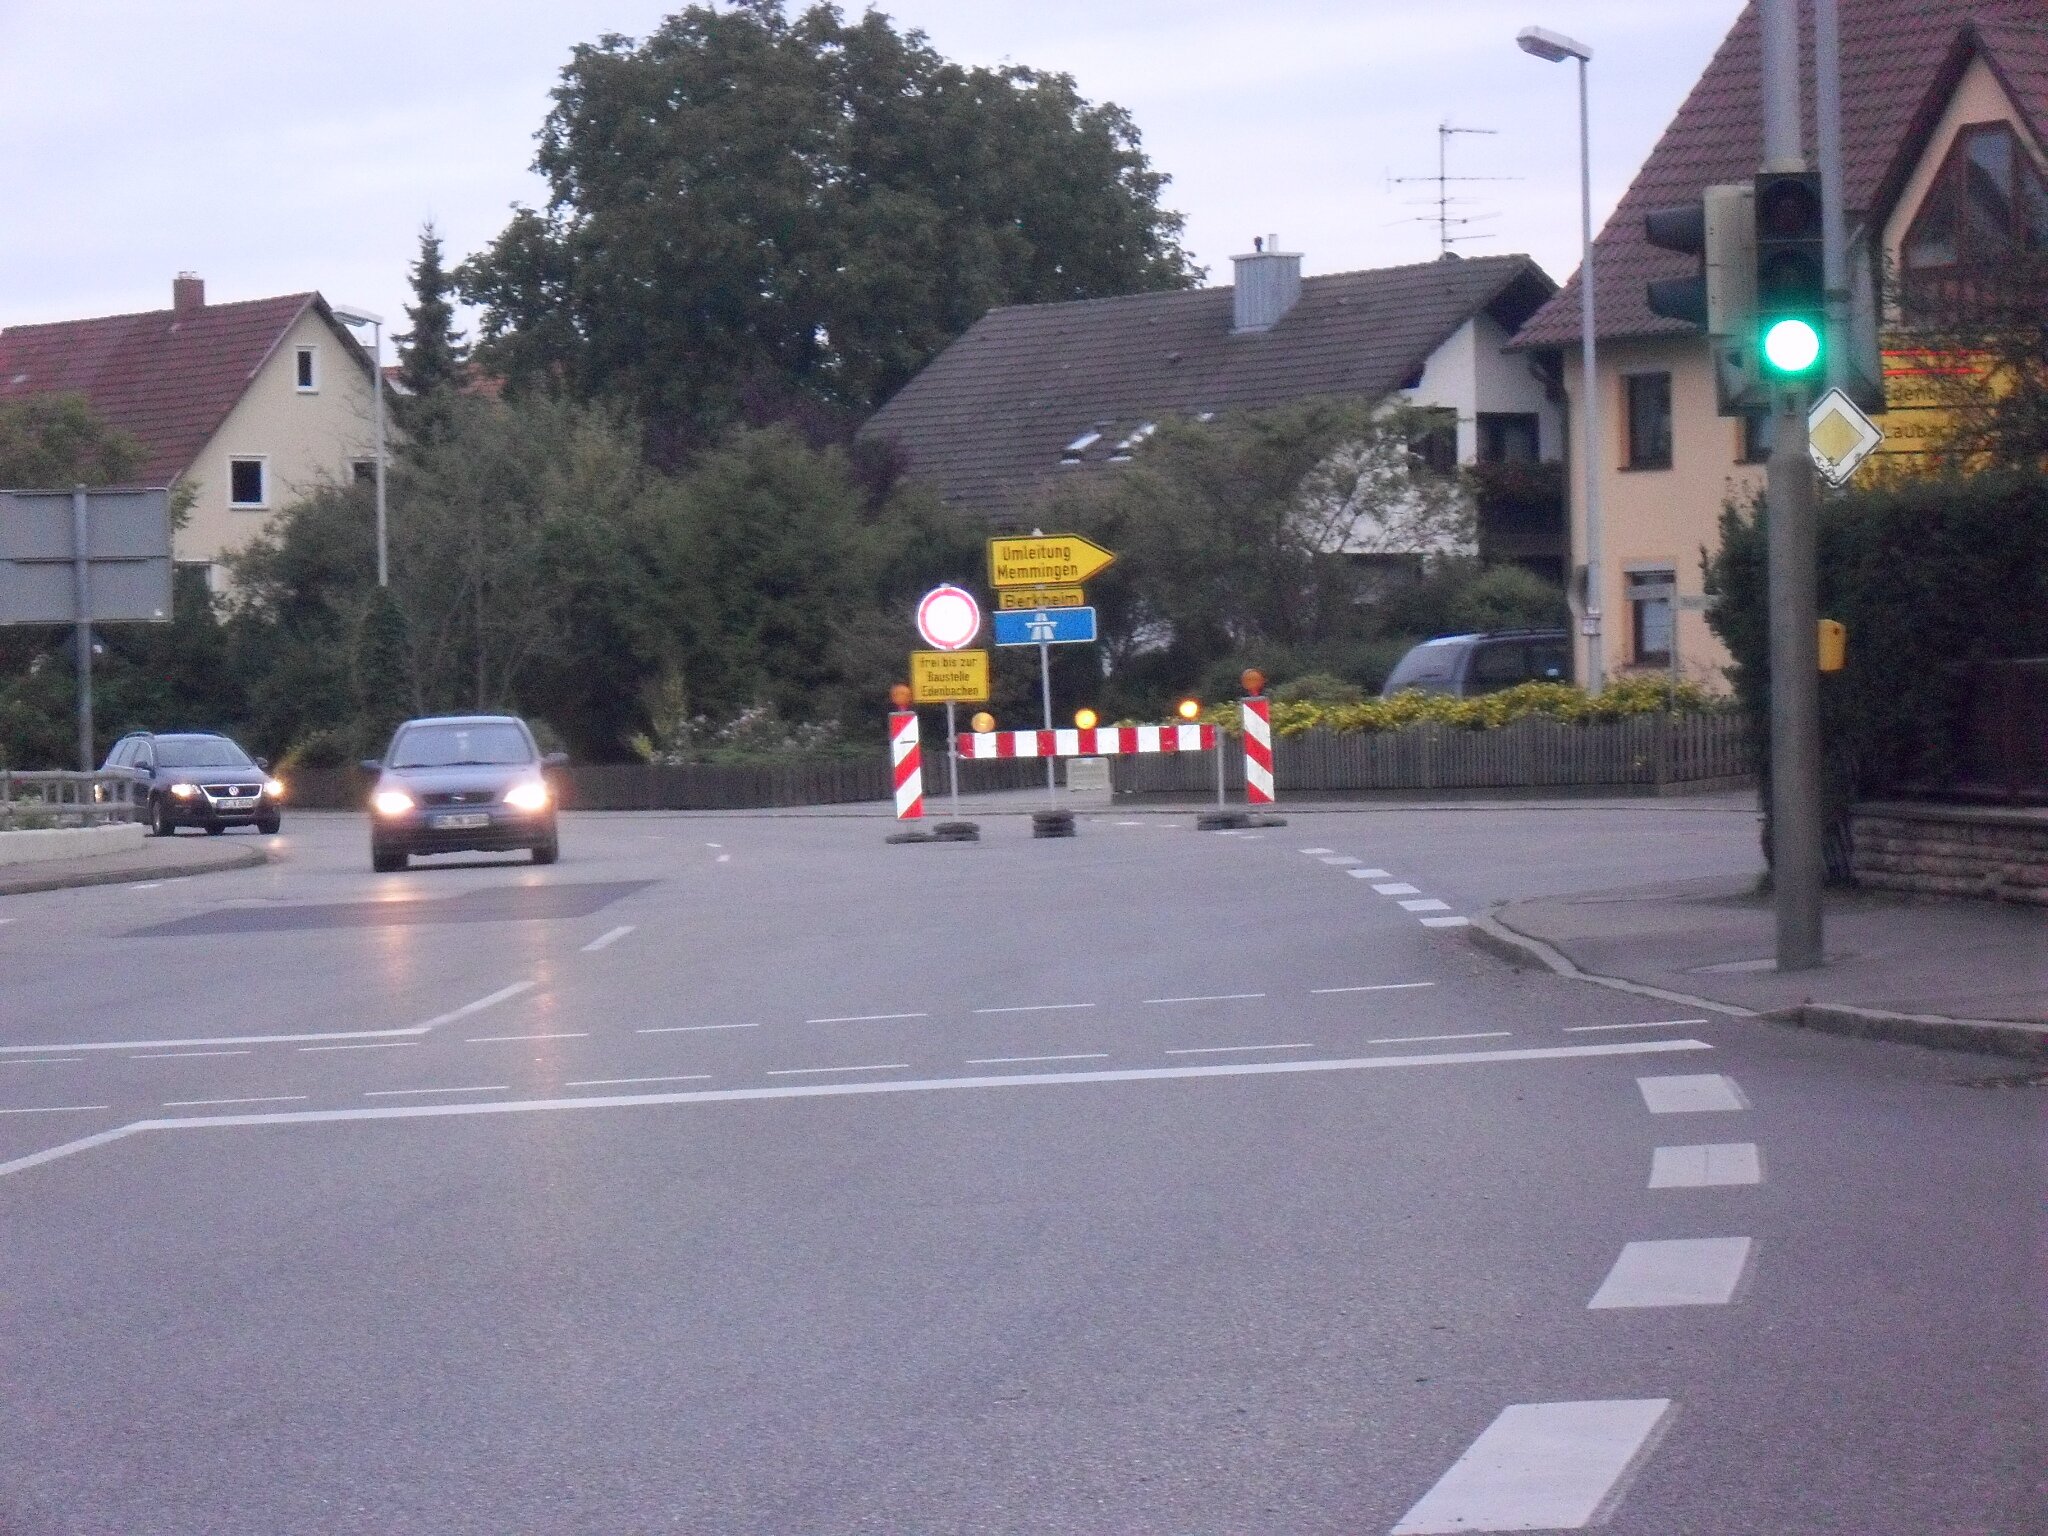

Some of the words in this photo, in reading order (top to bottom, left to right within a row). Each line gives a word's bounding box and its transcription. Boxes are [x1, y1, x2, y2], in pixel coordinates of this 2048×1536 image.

[1003, 545, 1071, 561] Umleitung
[997, 563, 1078, 580] Memmingen
[943, 656, 957, 667] bis
[960, 658, 977, 667] zur
[928, 670, 970, 682] Baustelle
